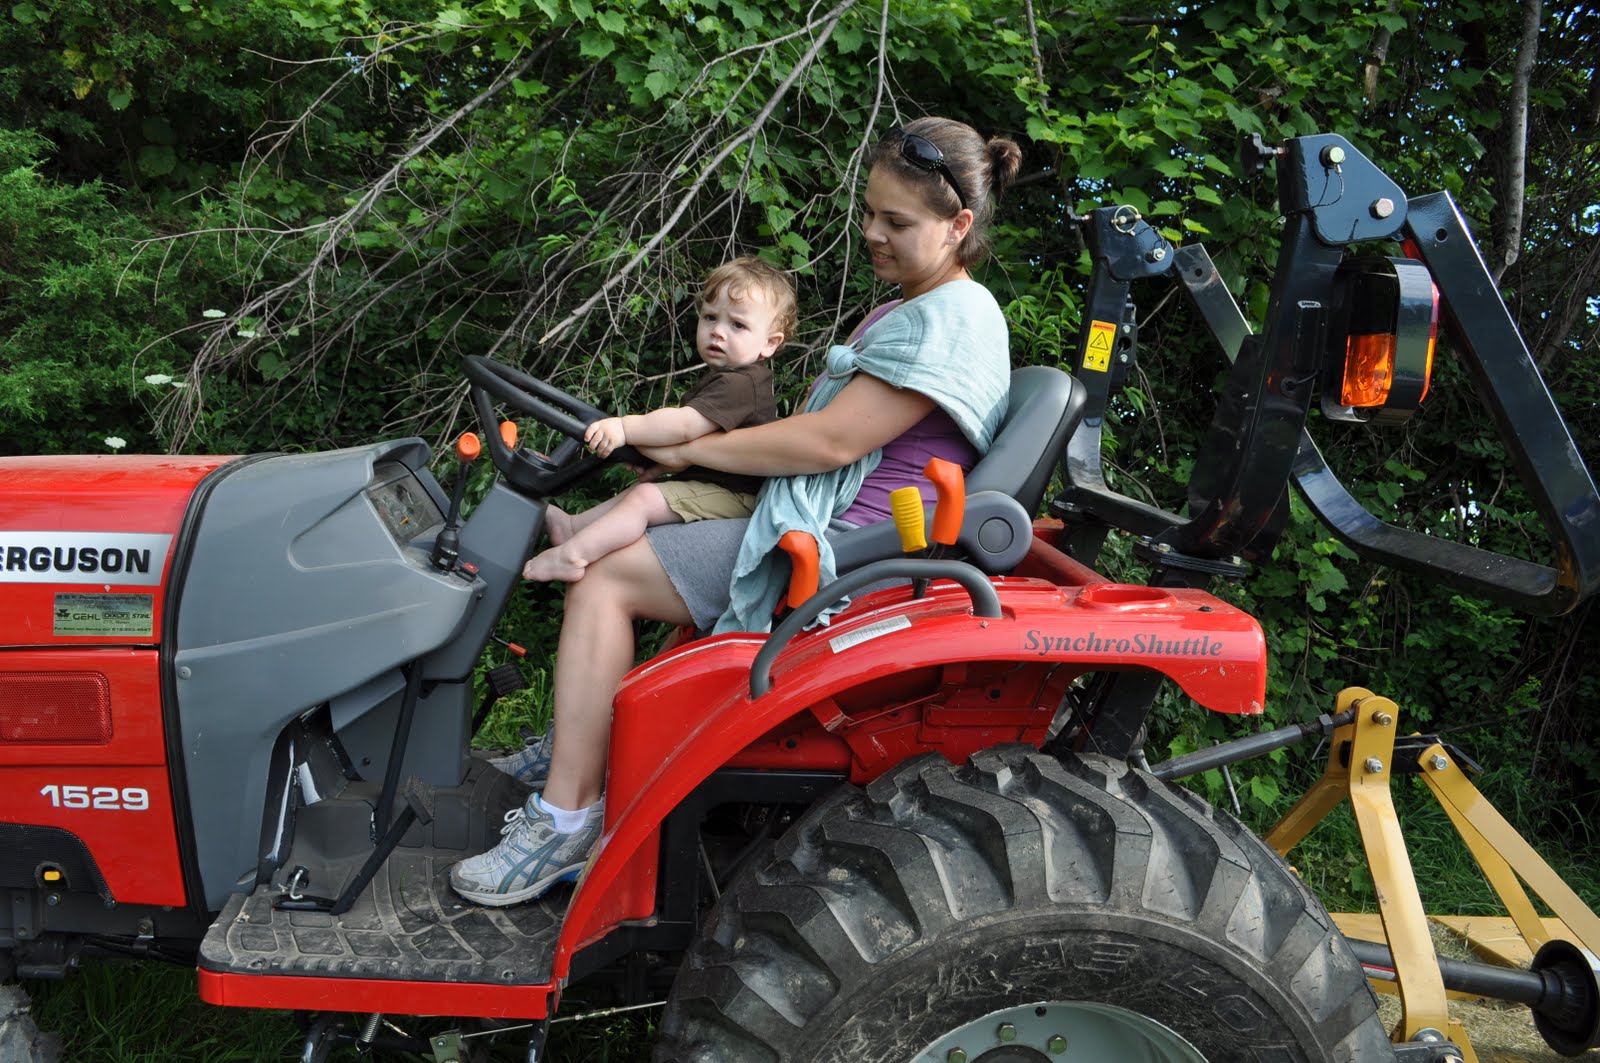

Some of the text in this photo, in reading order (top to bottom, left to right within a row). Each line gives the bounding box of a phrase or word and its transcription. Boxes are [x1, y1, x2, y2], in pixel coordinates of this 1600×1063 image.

[0, 546, 152, 573] RGUSON
[72, 613, 101, 621] GEHL
[1024, 630, 1224, 656] SynchroShuttle
[40, 784, 149, 811] 1529
